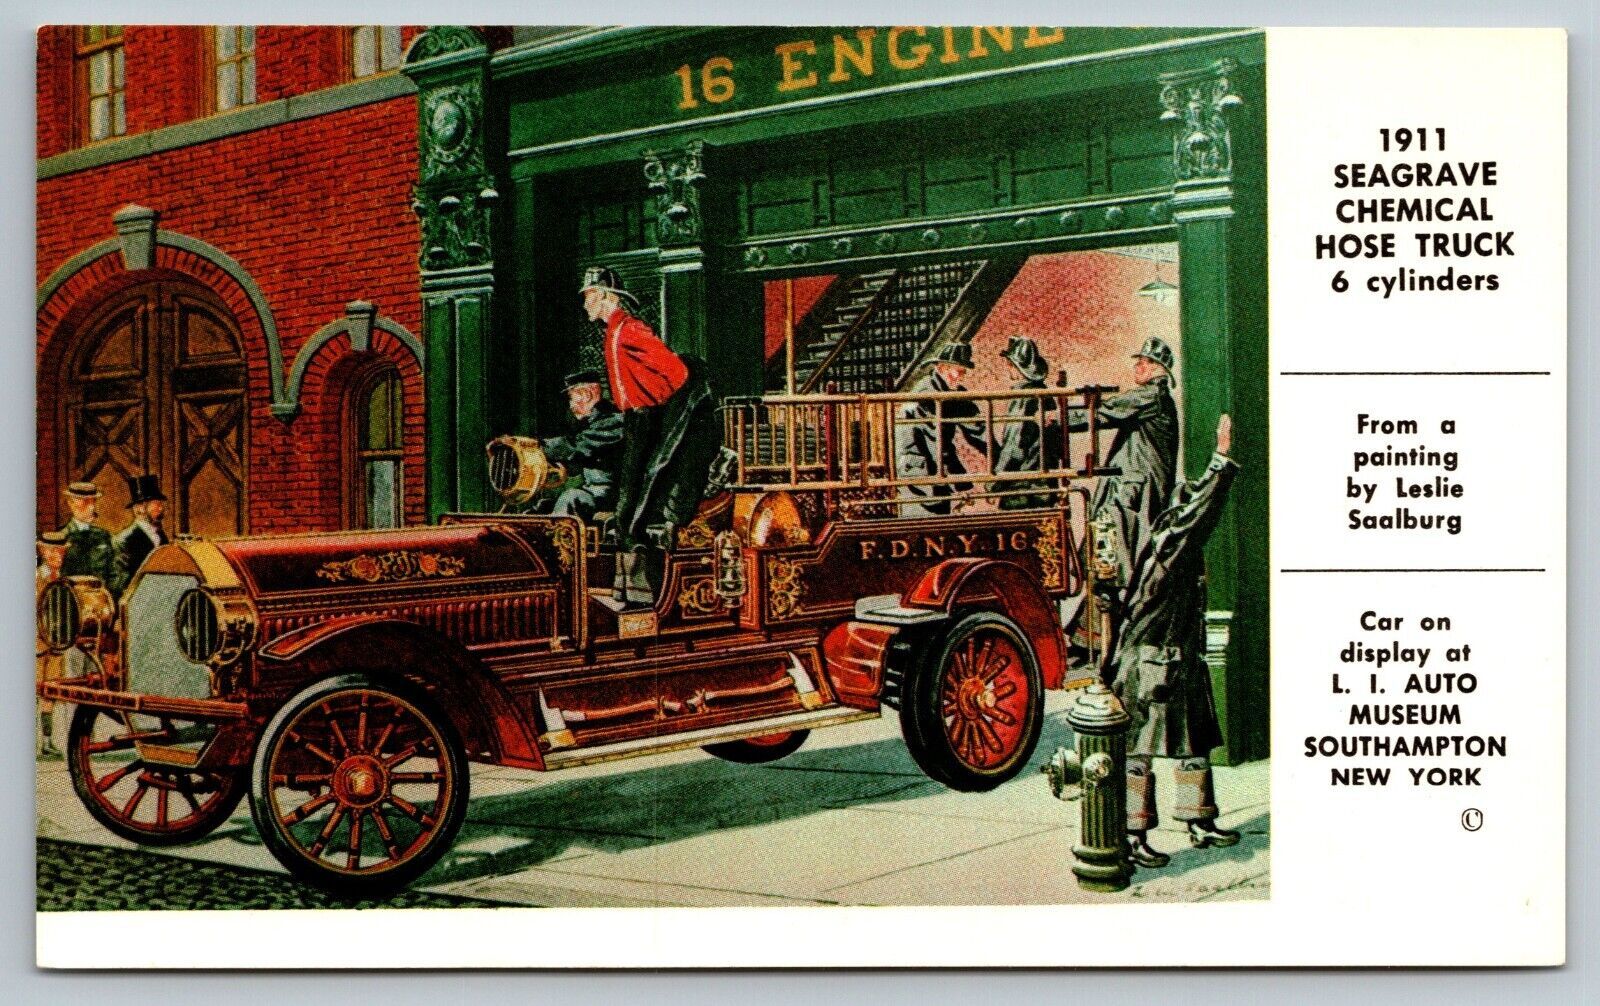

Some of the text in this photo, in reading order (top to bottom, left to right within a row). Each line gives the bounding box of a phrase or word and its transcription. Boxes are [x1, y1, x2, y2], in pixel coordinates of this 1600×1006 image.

[675, 56, 736, 110] 16
[1380, 127, 1446, 152] 1911
[1334, 161, 1498, 188] SEAGRAVE
[1336, 197, 1494, 223] CHEMICAL
[1315, 231, 1515, 259] HOSE TRUCK
[1331, 266, 1500, 298] 6 cylinders
[1357, 413, 1456, 434] From a
[1353, 444, 1458, 472] painting
[1346, 476, 1464, 503] by Leslie
[1348, 508, 1462, 535] Saalburg
[1360, 610, 1451, 631] Car on
[1340, 641, 1471, 668] display at
[1332, 673, 1478, 694] L. I. AUTO
[1349, 704, 1462, 725] MUSEUM
[1304, 735, 1507, 757] SOUTHAMPTON
[1331, 767, 1482, 786] NEW YORK
